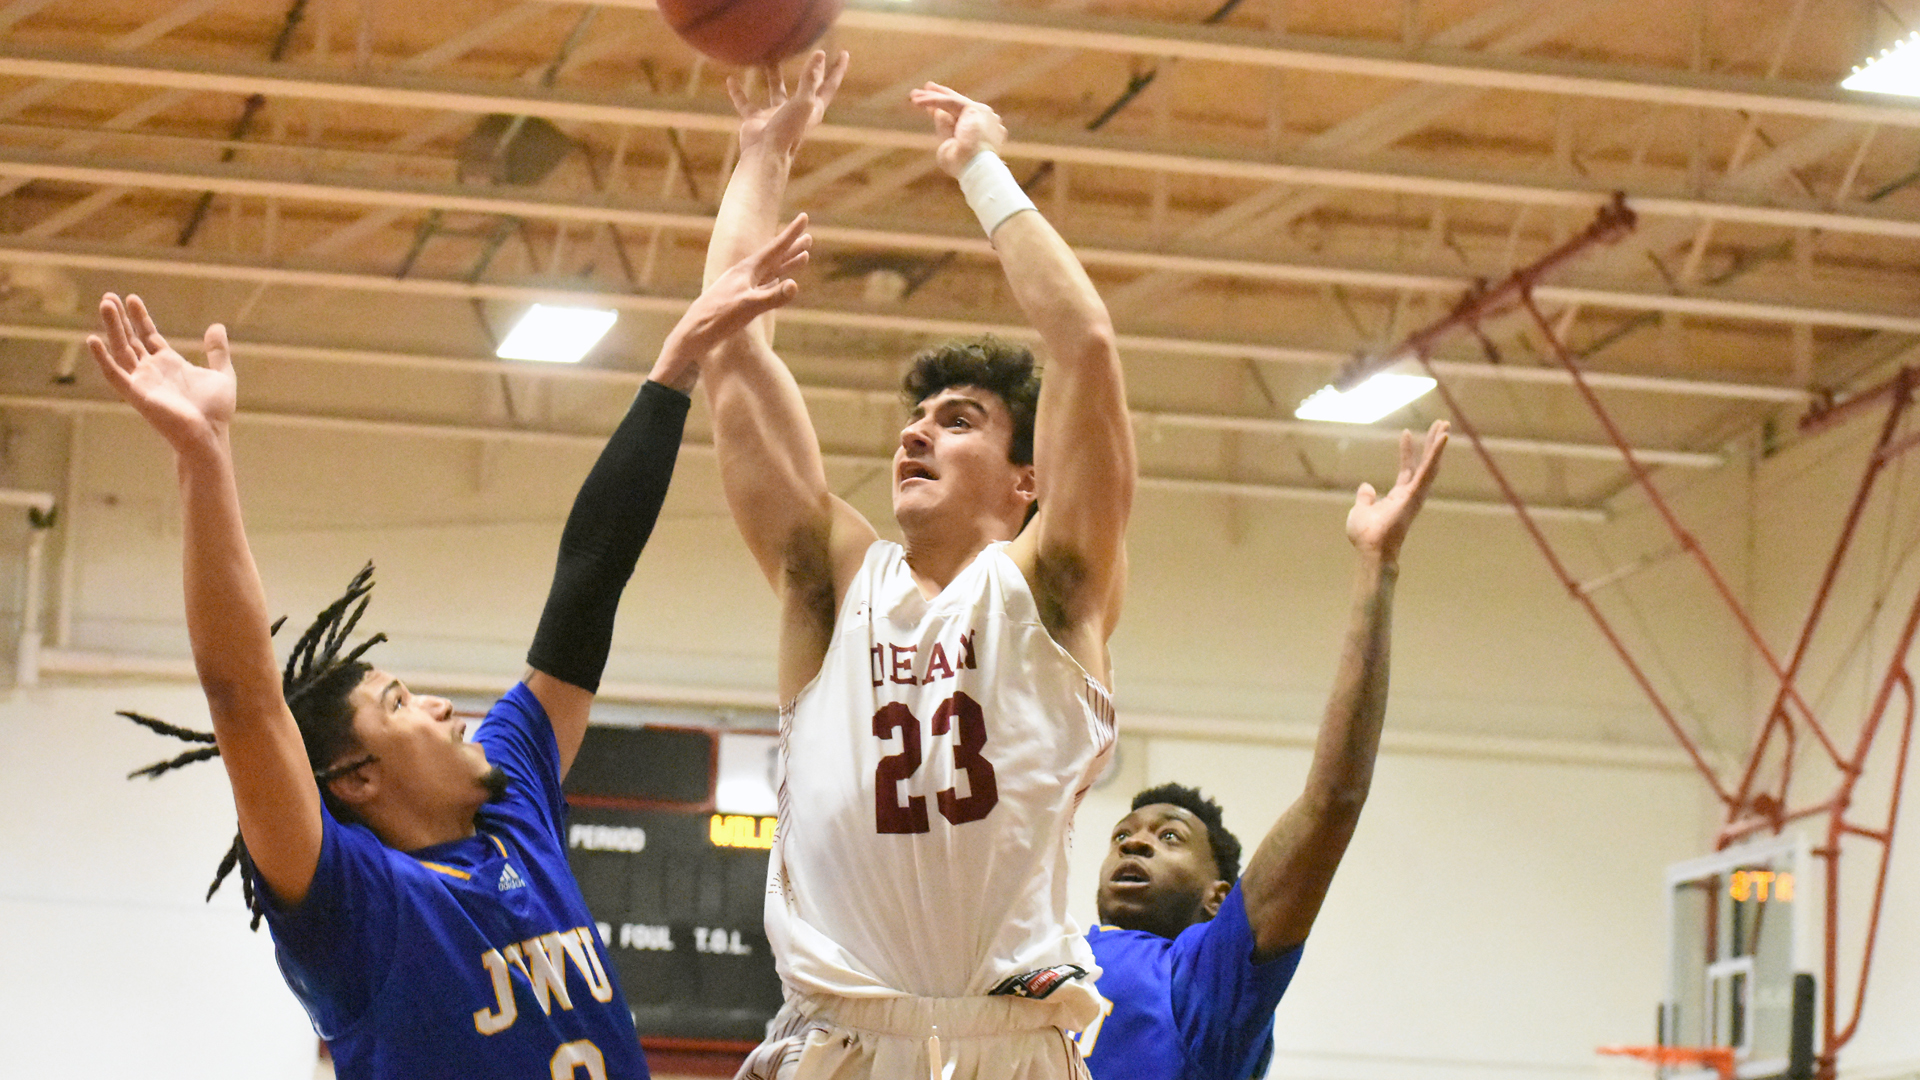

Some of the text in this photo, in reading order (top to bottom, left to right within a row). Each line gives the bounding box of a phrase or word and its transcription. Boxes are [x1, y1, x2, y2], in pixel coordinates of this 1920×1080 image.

[870, 629, 977, 687] DEAN
[872, 691, 999, 834] 23
[569, 824, 646, 853] PERIOD
[498, 877, 526, 892] adidas
[620, 922, 675, 951] FOUL
[473, 926, 613, 1036] JWU
